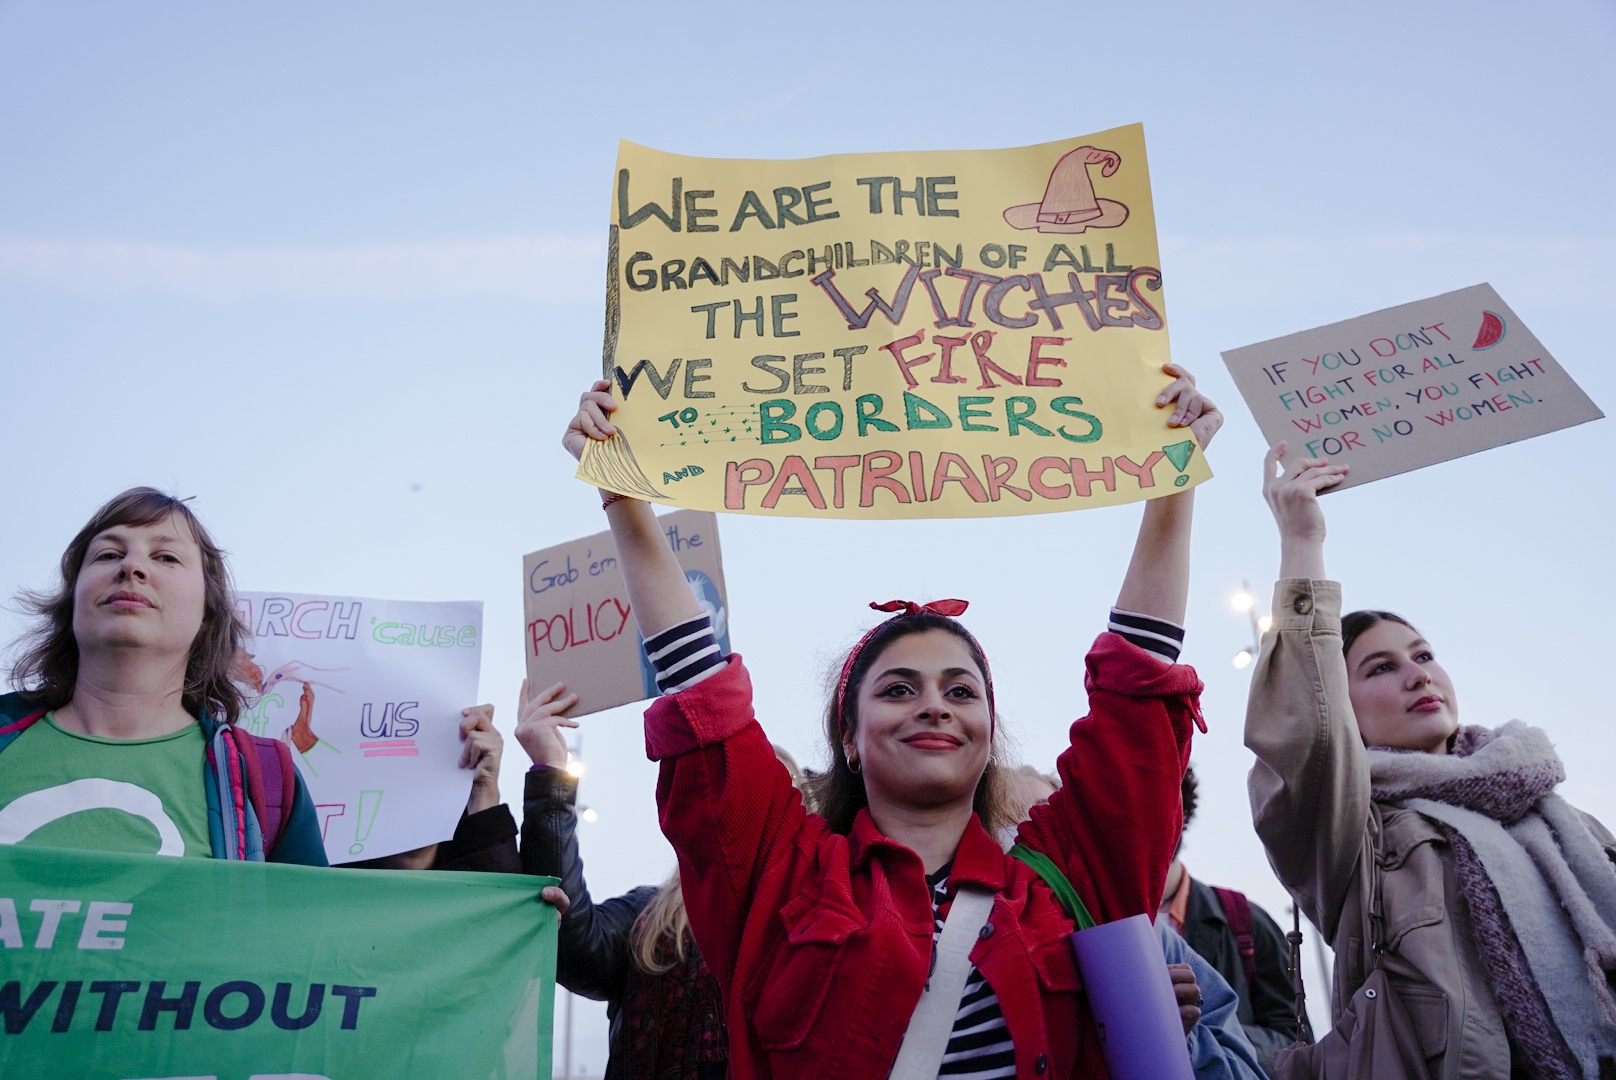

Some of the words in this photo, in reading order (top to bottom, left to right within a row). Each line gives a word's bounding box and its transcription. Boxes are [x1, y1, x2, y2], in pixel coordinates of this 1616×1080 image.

[617, 168, 720, 233] WE
[728, 180, 841, 233] ARE
[856, 175, 960, 218] THE
[624, 239, 963, 293] GRANDCHILDREN
[979, 242, 1028, 270] OF
[1042, 242, 1133, 273] ALL
[690, 293, 801, 340] THE
[809, 265, 1166, 332] WITCHES
[612, 358, 716, 401] WE
[740, 345, 868, 395] SET
[878, 327, 1073, 392] FIRE
[1262, 361, 1288, 386] IF
[1301, 348, 1361, 376] YOU
[1369, 322, 1452, 357] DON'T
[1278, 376, 1355, 412] FIGHT
[1363, 364, 1414, 387] FOR
[1421, 353, 1465, 373] ALL
[1405, 382, 1460, 404] YOU
[1467, 358, 1546, 390] FIGHT
[658, 407, 698, 428] TO
[759, 393, 1103, 446] BORDERS
[1304, 431, 1367, 459] FOR
[1371, 419, 1414, 444] NO
[1424, 389, 1544, 427] WOMEN.
[663, 465, 705, 485] AND
[724, 439, 1197, 510] PATRIARCHY!
[666, 525, 704, 553] the
[528, 597, 631, 657] POLICY
